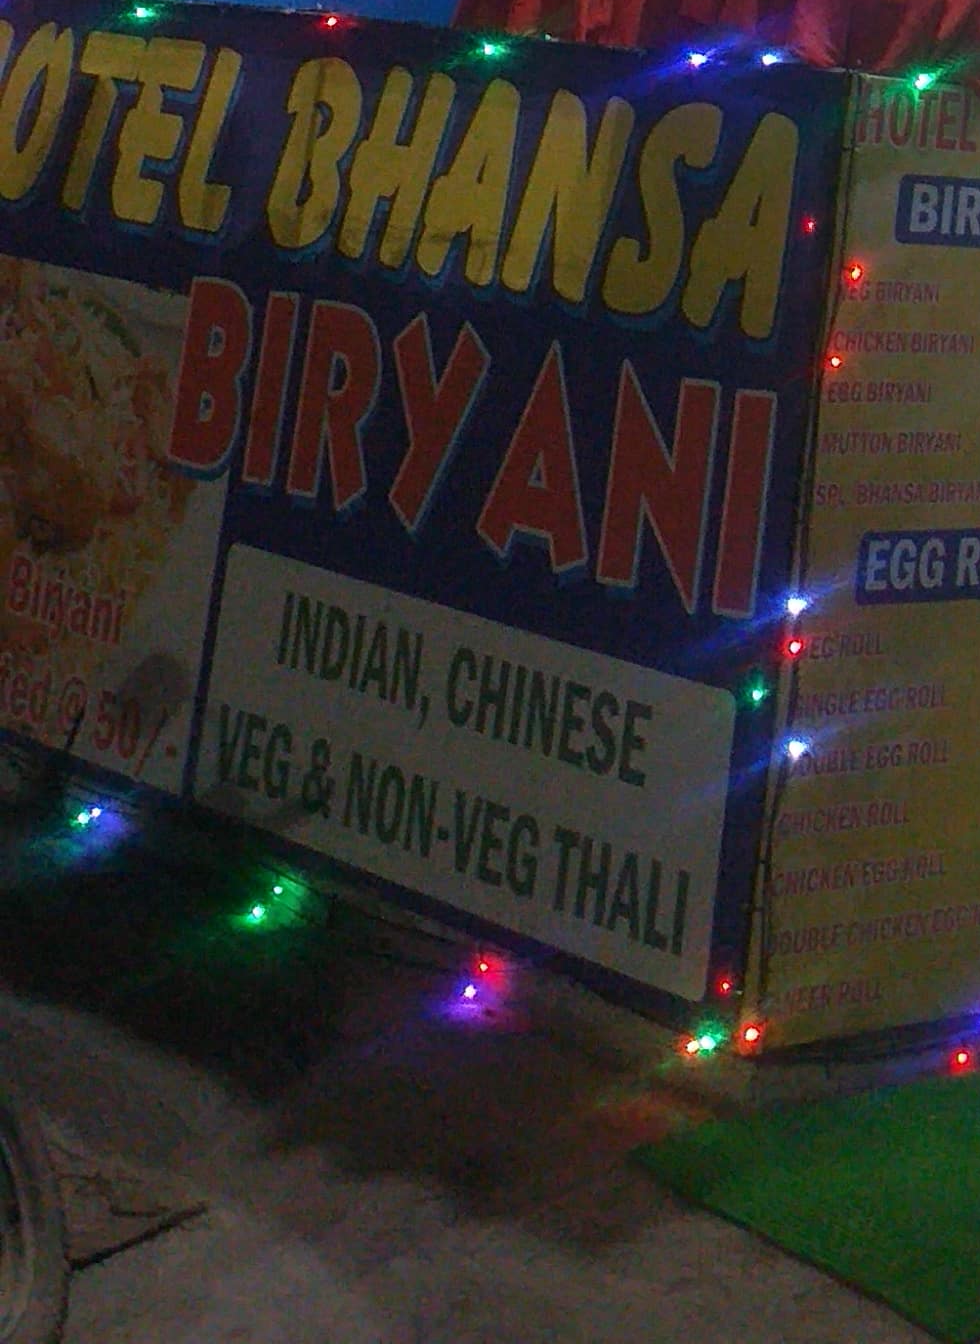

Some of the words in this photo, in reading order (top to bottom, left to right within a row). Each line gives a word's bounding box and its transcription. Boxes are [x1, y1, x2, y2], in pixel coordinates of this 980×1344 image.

[857, 83, 977, 152] HOTEL
[0, 18, 242, 234] OTEL
[267, 57, 799, 340] BHANSA
[875, 281, 941, 304] BIRYANI
[833, 330, 906, 353] CHICKEN
[911, 330, 976, 353] BIRYANI
[866, 381, 932, 404] BIRYANI
[168, 276, 778, 619] BIRYANI
[865, 534, 945, 592] EGG
[806, 636, 832, 659] EG
[277, 591, 431, 730] INDIAN,
[445, 647, 653, 787] CHINESE
[793, 747, 860, 778] OUBLE
[215, 703, 293, 800] VEG
[302, 738, 332, 818] &
[344, 752, 540, 902] NON-VEG
[553, 825, 690, 959] THALI
